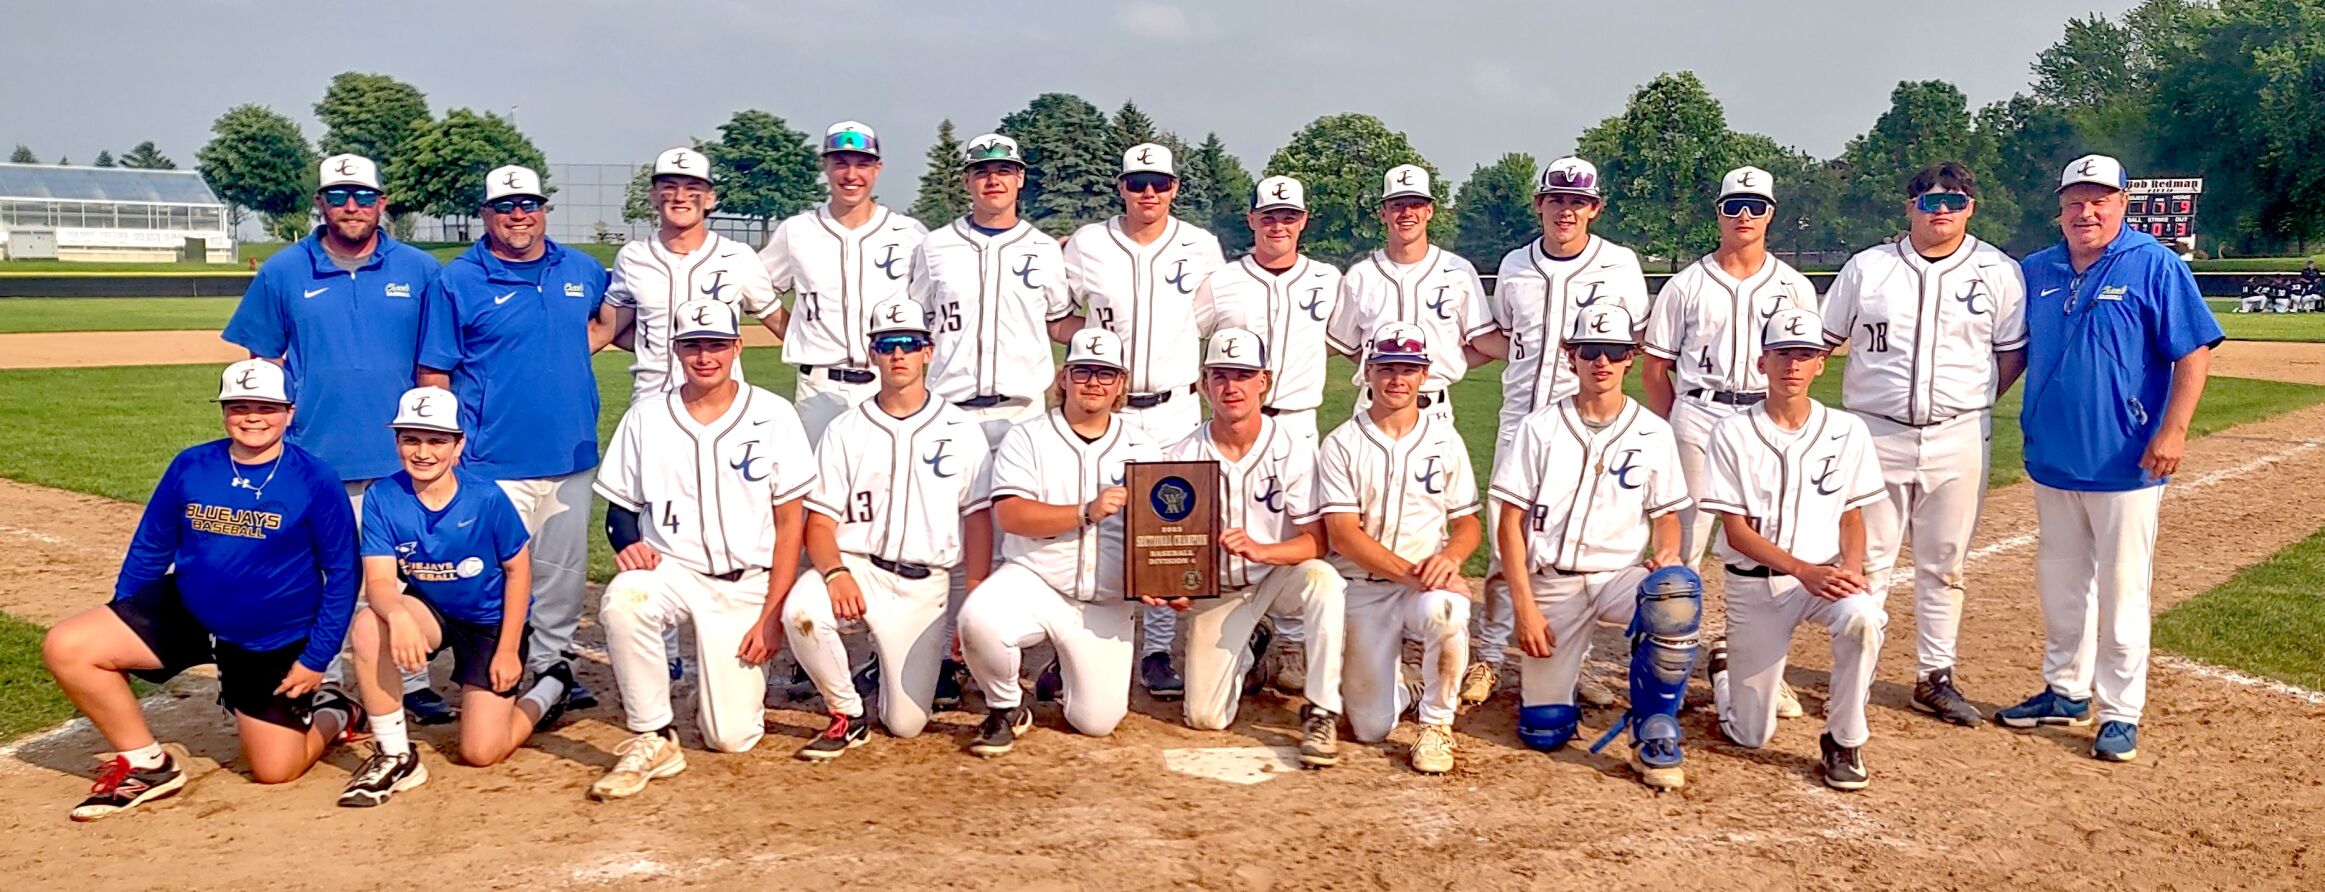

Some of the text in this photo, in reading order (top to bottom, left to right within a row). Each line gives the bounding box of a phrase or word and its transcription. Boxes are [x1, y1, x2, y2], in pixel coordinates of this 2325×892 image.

[2151, 180, 2198, 192] Redman
[939, 301, 962, 333] 15
[1862, 322, 1888, 352] 18
[185, 503, 282, 530] BLUEJAYS
[662, 500, 680, 534] 4
[844, 490, 873, 524] 13
[191, 518, 266, 539] BASEBALL
